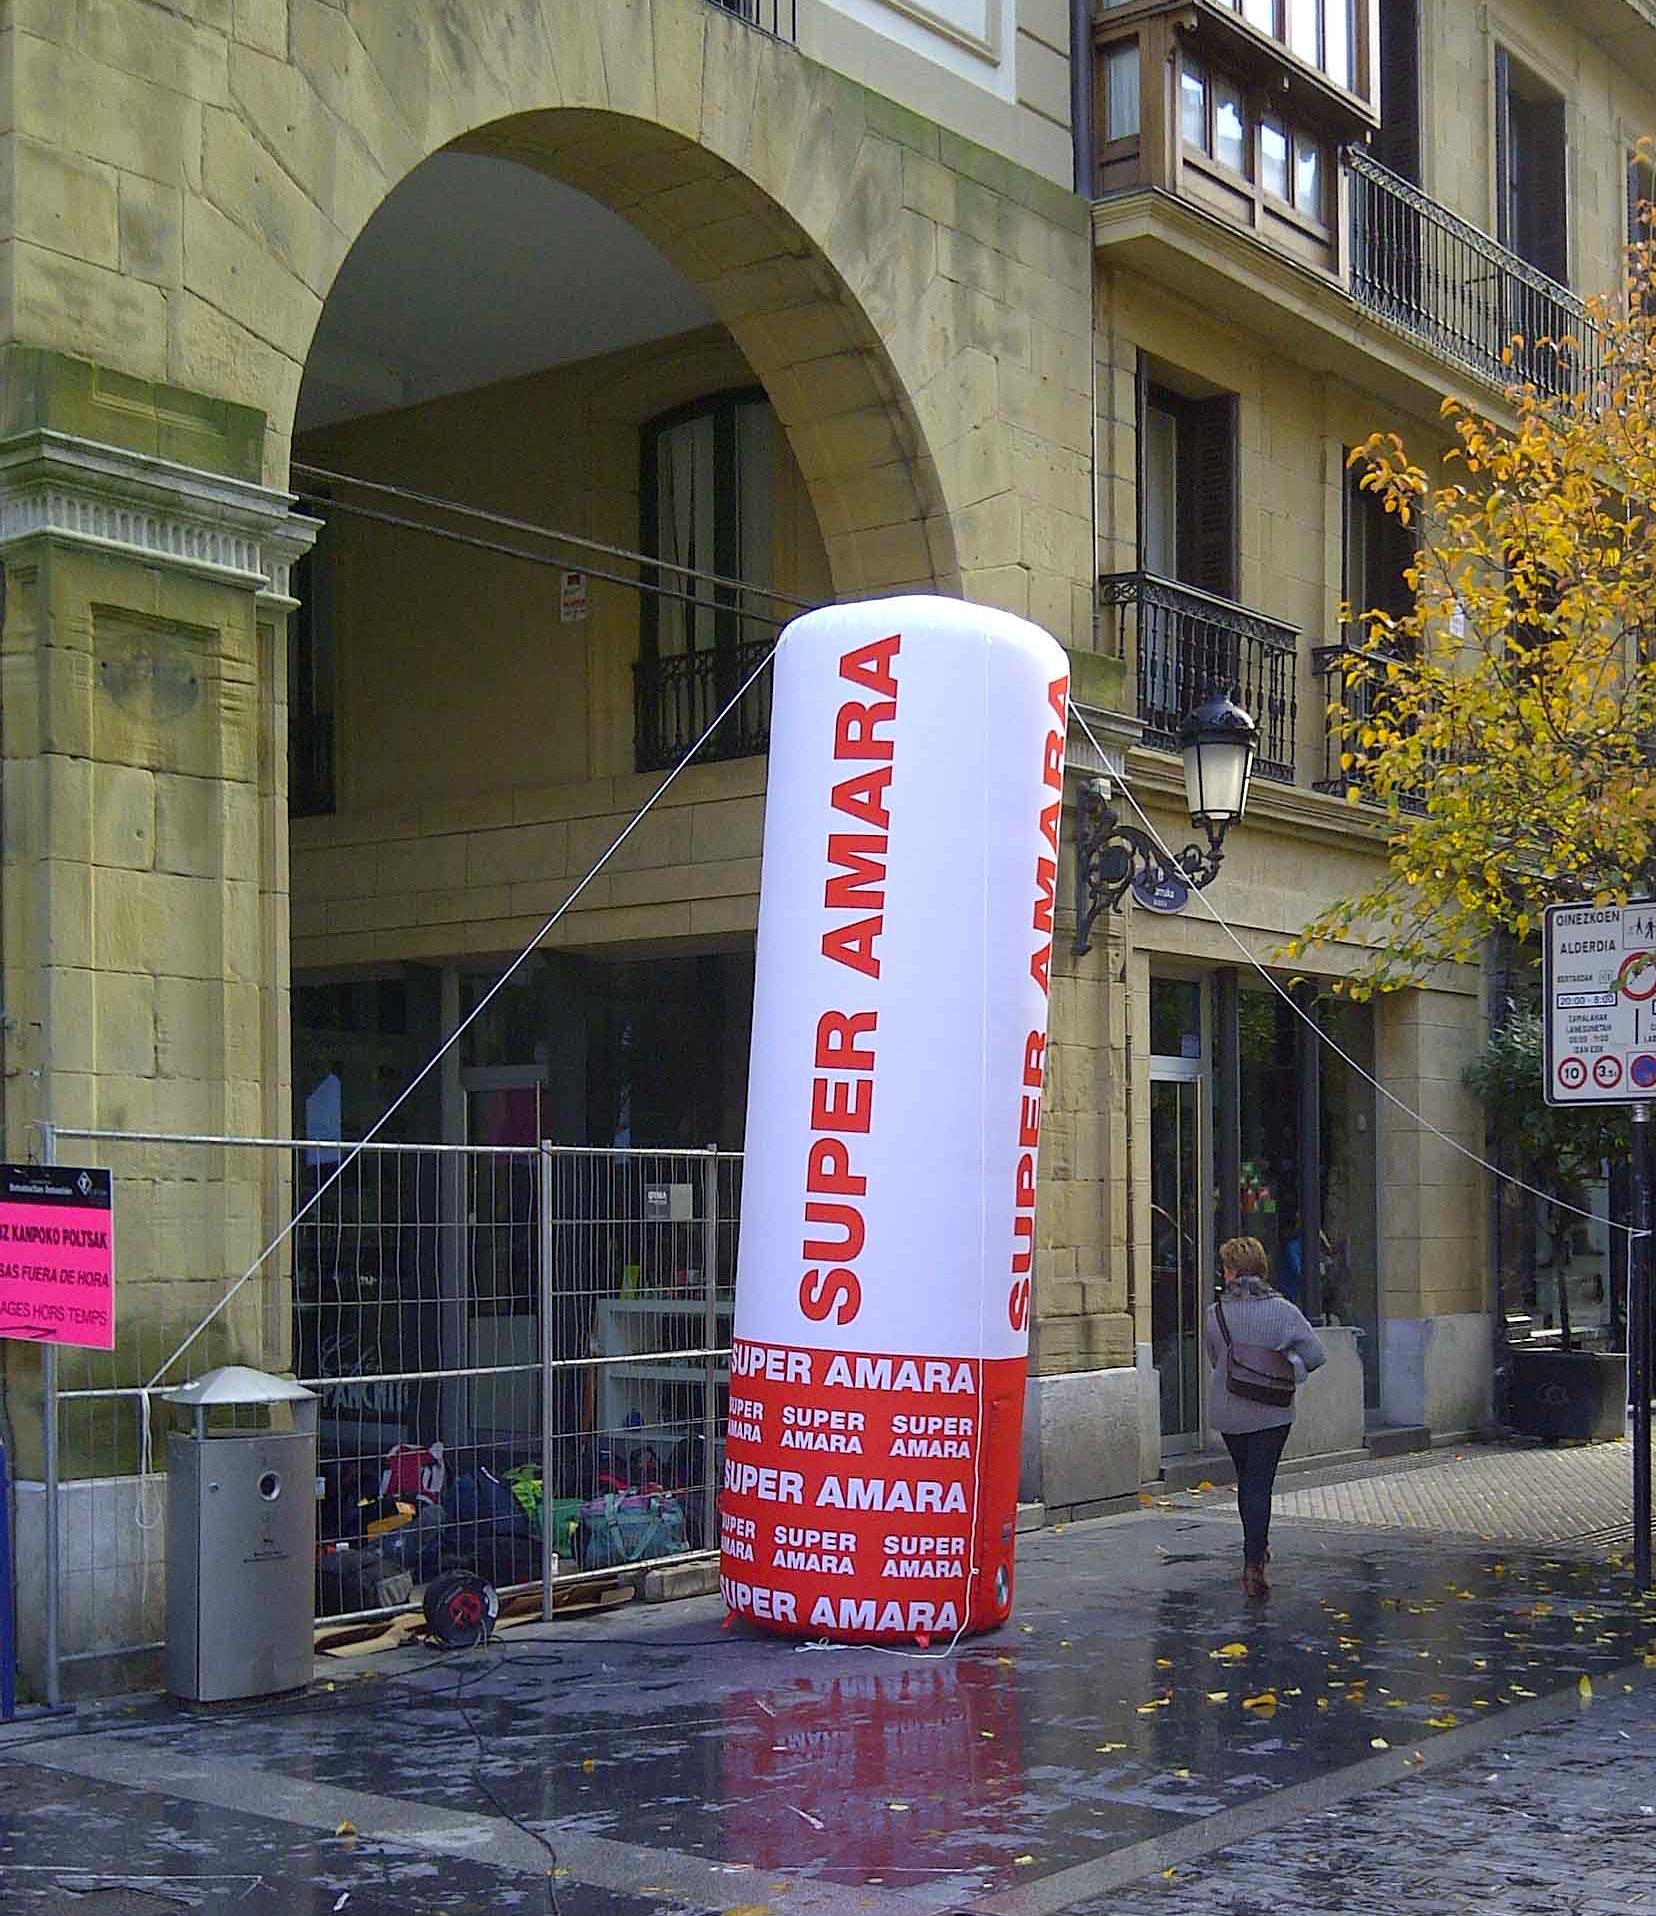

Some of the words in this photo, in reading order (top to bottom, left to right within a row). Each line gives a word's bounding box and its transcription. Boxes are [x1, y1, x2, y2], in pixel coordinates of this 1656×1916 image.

[821, 633, 902, 980] AMARA
[1560, 940, 1616, 954] ALDERDIA
[1008, 1029, 1047, 1332] SUPER
[1029, 675, 1069, 997] AMARA
[1564, 1067, 1579, 1080] 10
[799, 1010, 878, 1326] SUPER
[12, 1225, 60, 1246] KANPOKO
[62, 1228, 108, 1250] POLTSAK
[22, 1265, 58, 1282] FUERA
[60, 1268, 75, 1285] DE
[77, 1270, 109, 1288] HORA
[33, 1303, 65, 1322] HORS
[67, 1306, 108, 1326] TEMPS
[731, 1341, 812, 1385] SUPER
[823, 1355, 976, 1395] AMARA
[782, 1405, 865, 1432] SUPER
[890, 1414, 974, 1437] SUPER
[780, 1429, 864, 1455] AMARA
[889, 1438, 972, 1460] AMARA
[724, 1458, 804, 1505] SUPER
[815, 1475, 968, 1514] AMARA
[774, 1525, 857, 1552] SUPER
[883, 1535, 965, 1556] SUPER
[772, 1549, 855, 1576] AMARA
[881, 1559, 963, 1579] AMARA
[810, 1595, 959, 1632] AMARA
